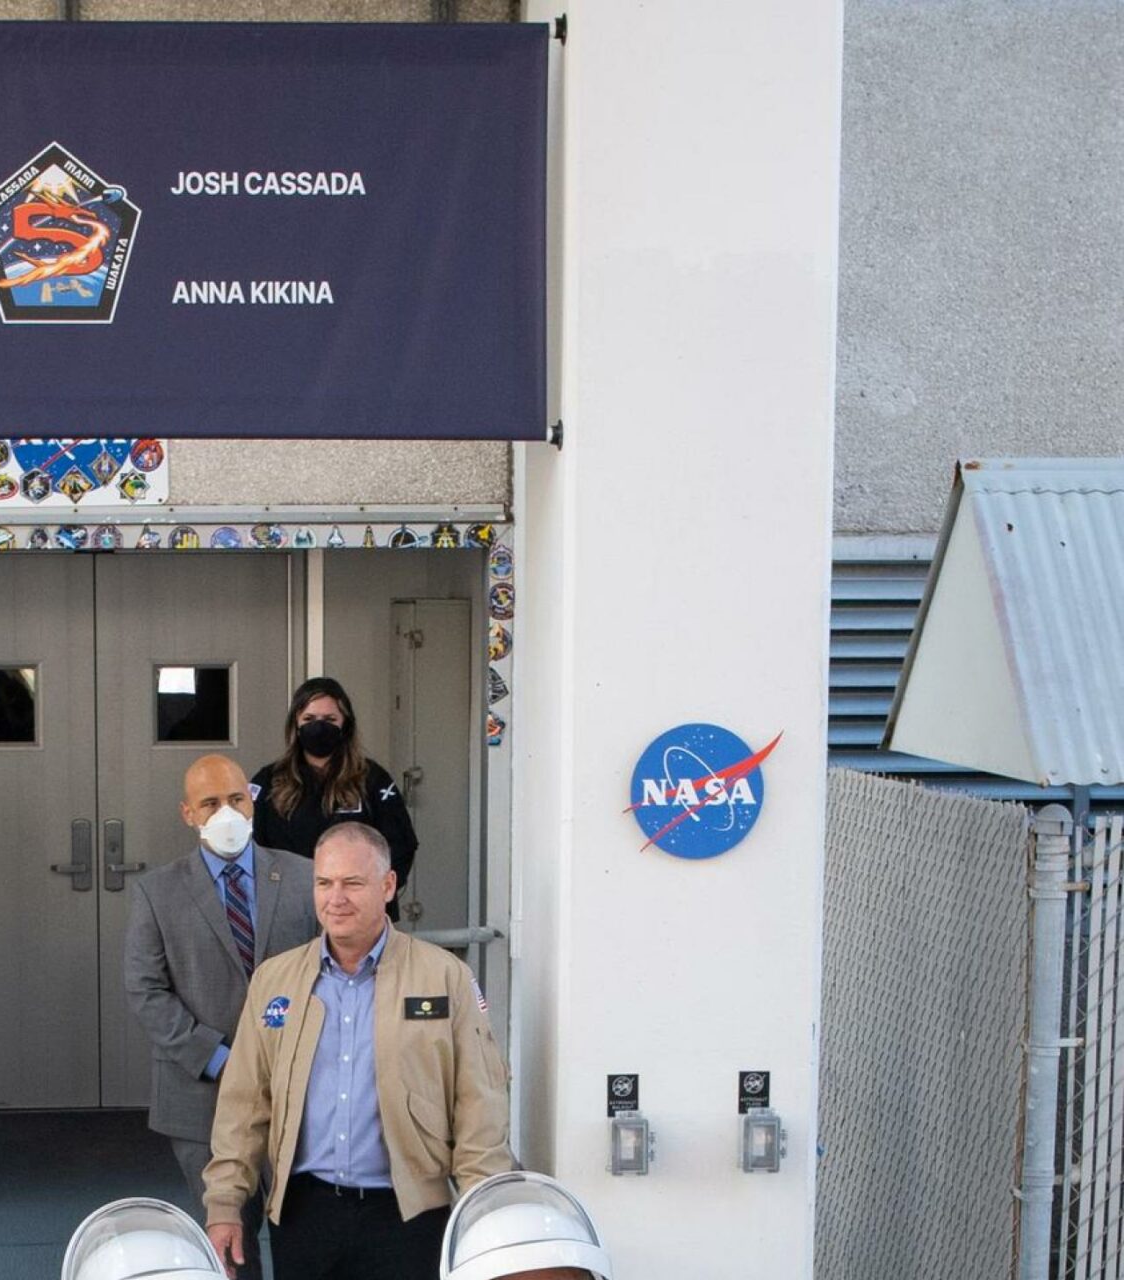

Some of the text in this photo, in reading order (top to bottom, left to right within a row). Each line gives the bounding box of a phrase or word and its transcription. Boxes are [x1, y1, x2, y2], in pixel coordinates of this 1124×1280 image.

[170, 171, 367, 196] JOSH CASSADA
[172, 280, 335, 304] ANNA KIKINA
[641, 777, 757, 807] NASA
